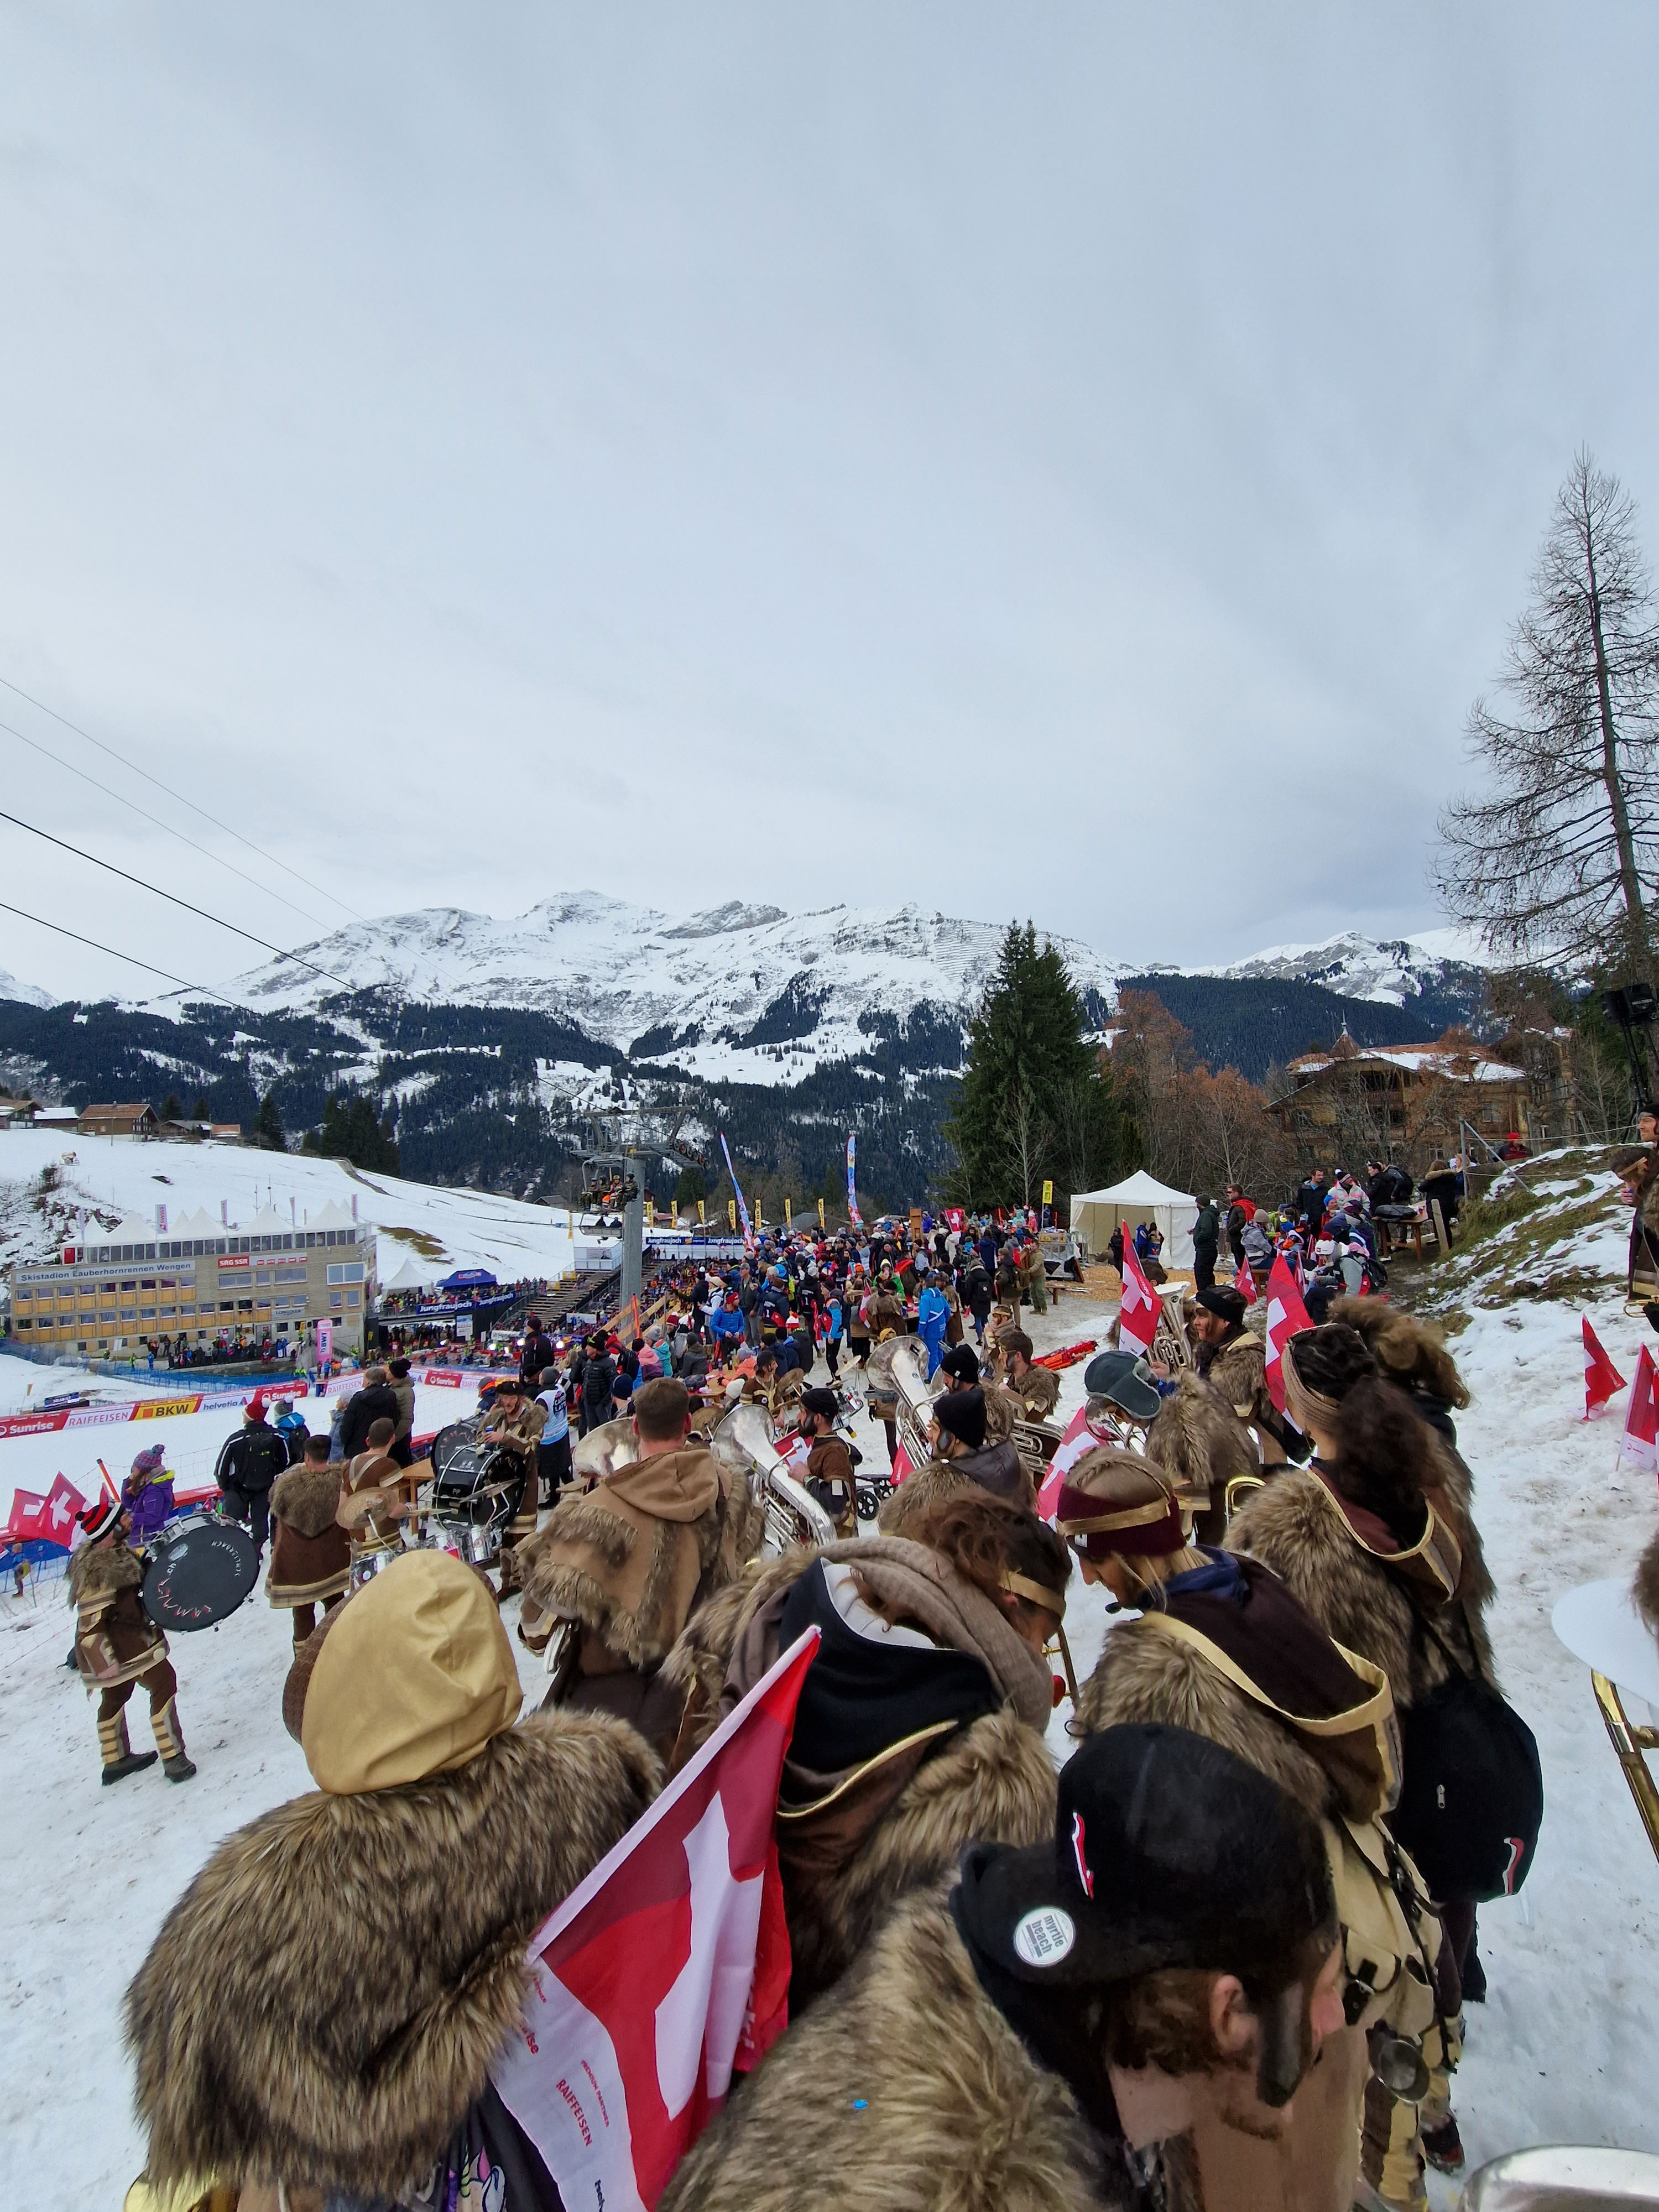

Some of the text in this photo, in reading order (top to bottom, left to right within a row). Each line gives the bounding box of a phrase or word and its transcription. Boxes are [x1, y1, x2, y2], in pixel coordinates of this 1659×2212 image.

[21, 1263, 191, 1281] Skistadion Lauberhornrennen Wengen
[479, 1292, 514, 1306] Jungfraujoch
[419, 1301, 473, 1313] Jungfraujoch
[328, 1380, 362, 1394] RAIFFEISEN
[435, 1378, 456, 1386] Sunrise
[155, 1404, 189, 1417] BKW
[203, 1400, 238, 1411] helvetia
[69, 1412, 128, 1427] RAIFFEISEN
[9, 1421, 54, 1434] Sunrise
[1031, 1919, 1053, 1954] beach
[1043, 1914, 1064, 1947] myrtle
[556, 2078, 592, 2147] RAIFFEISEN
[596, 2090, 609, 2127] PARTNER
